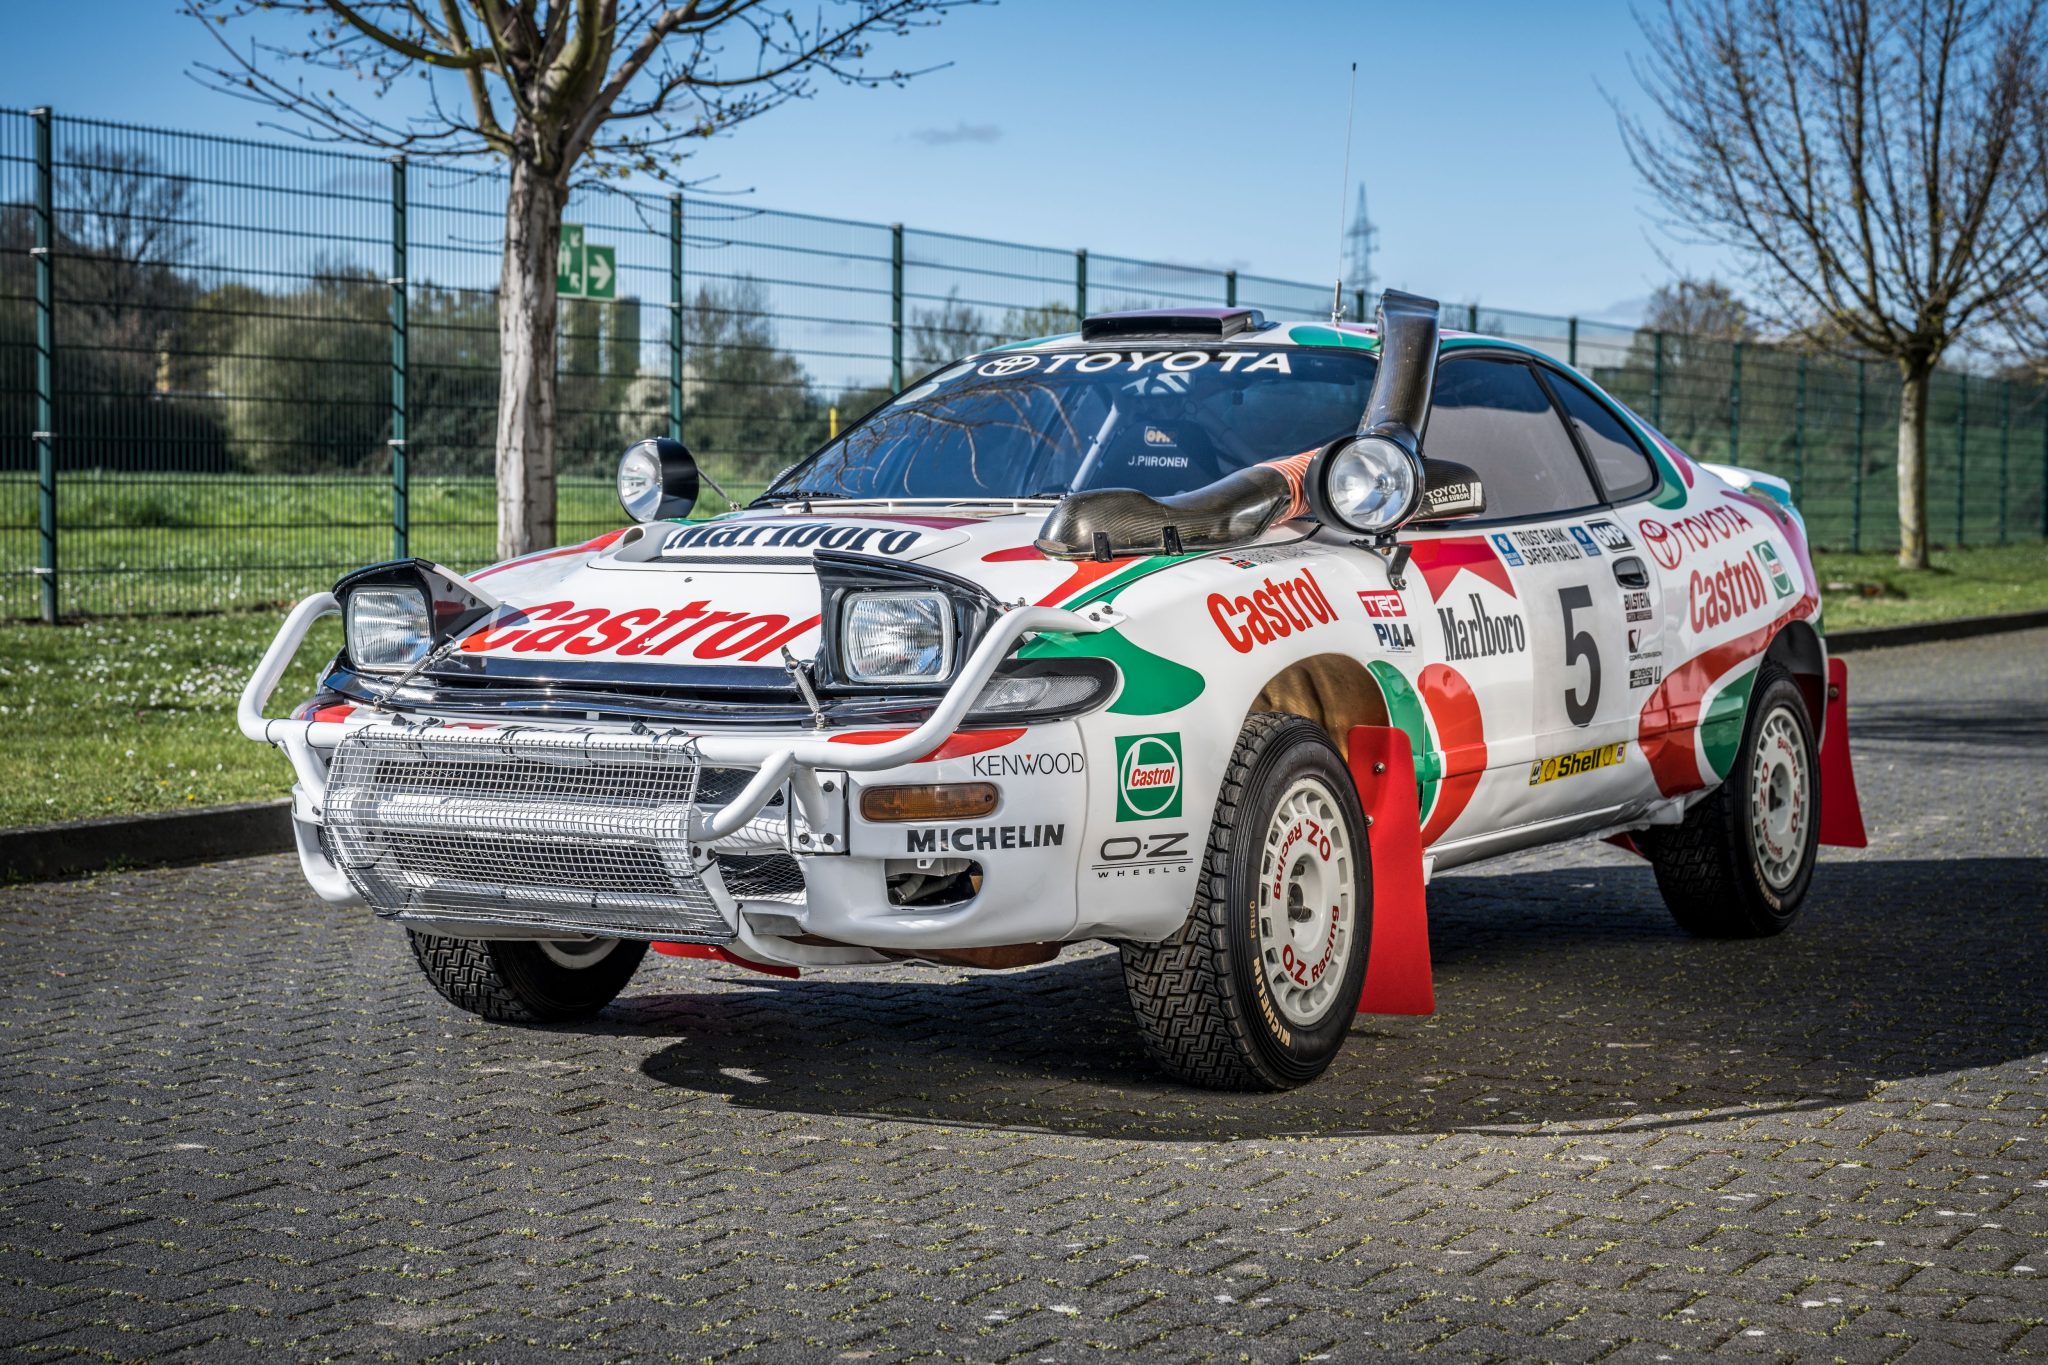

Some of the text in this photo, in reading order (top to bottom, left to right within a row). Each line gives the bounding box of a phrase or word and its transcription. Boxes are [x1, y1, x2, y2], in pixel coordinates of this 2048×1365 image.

[1043, 352, 1292, 375] TOYOTA
[1128, 456, 1189, 468] J.PIIRONEN
[1425, 483, 1469, 499] TOYOTA
[1429, 492, 1470, 505] TEAM EUROPE
[663, 523, 922, 555] Marlboro
[1512, 527, 1569, 547] TRUST BANK
[1592, 524, 1626, 547] OMP
[1671, 504, 1754, 552] TOYOTA
[1522, 547, 1556, 565] SAFARI
[1552, 543, 1583, 562] RALLY
[1624, 592, 1652, 611] BILSTEIN
[1690, 550, 1768, 634] Castrol
[1207, 568, 1339, 653] Castrol
[1361, 594, 1403, 617] TRD
[460, 600, 822, 662] Castrol
[1373, 623, 1416, 647] PIAA
[1437, 593, 1525, 661] Marlboro
[1558, 585, 1601, 728] 5
[972, 753, 1084, 777] KENWOOD
[1558, 748, 1602, 777] Shell
[1131, 766, 1175, 787] Castrol
[907, 824, 1065, 853] MICHELIN
[1097, 866, 1187, 879] WHEELS
[1273, 822, 1303, 900] Racing
[1311, 905, 1340, 983] Racing
[1253, 956, 1291, 1048] MICHELIN
